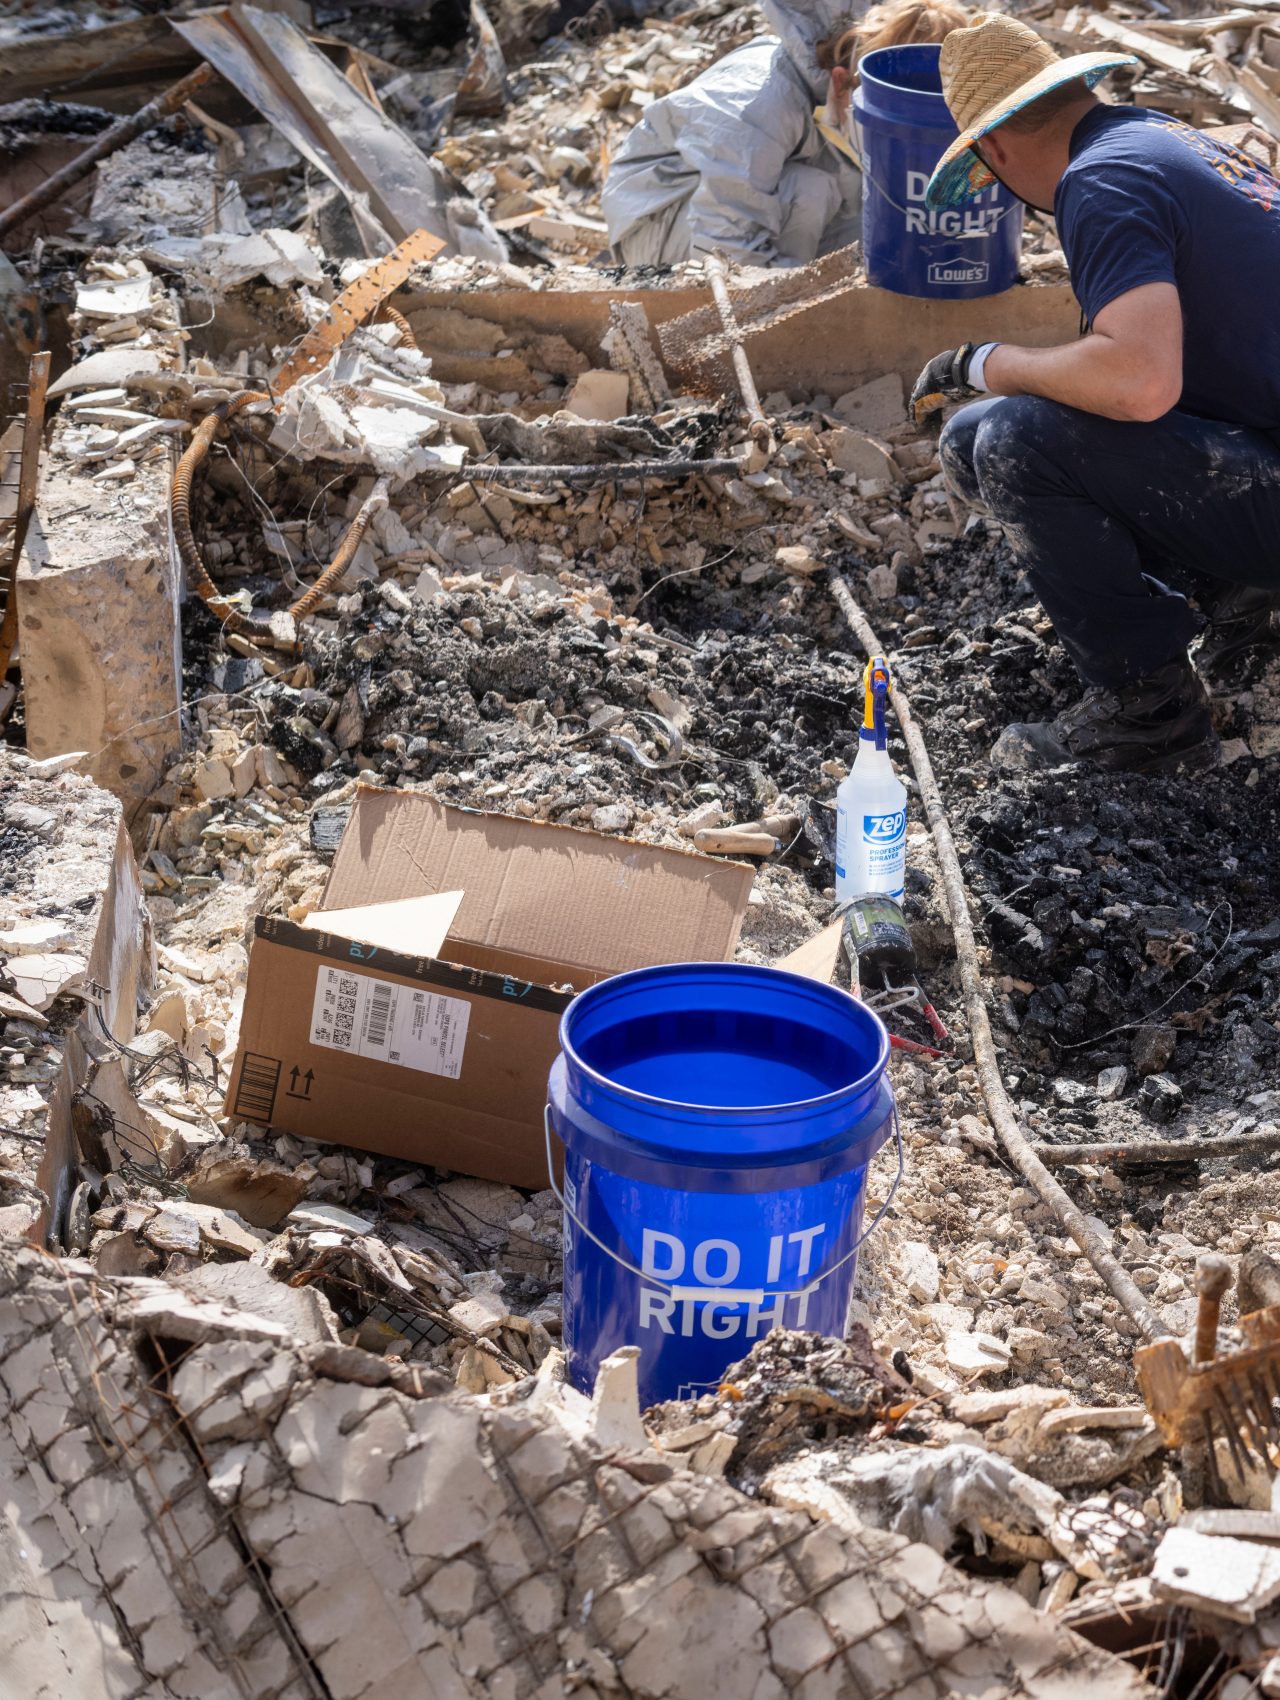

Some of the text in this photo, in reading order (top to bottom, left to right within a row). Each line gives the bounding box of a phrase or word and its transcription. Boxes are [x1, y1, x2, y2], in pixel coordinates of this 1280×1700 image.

[906, 207, 1004, 236] RIGHT
[934, 267, 983, 281] LOWE'S
[870, 852, 899, 861] SPRAYER
[641, 1228, 741, 1286] DO
[766, 1223, 826, 1283] IT
[639, 1282, 820, 1339] RIGHT
